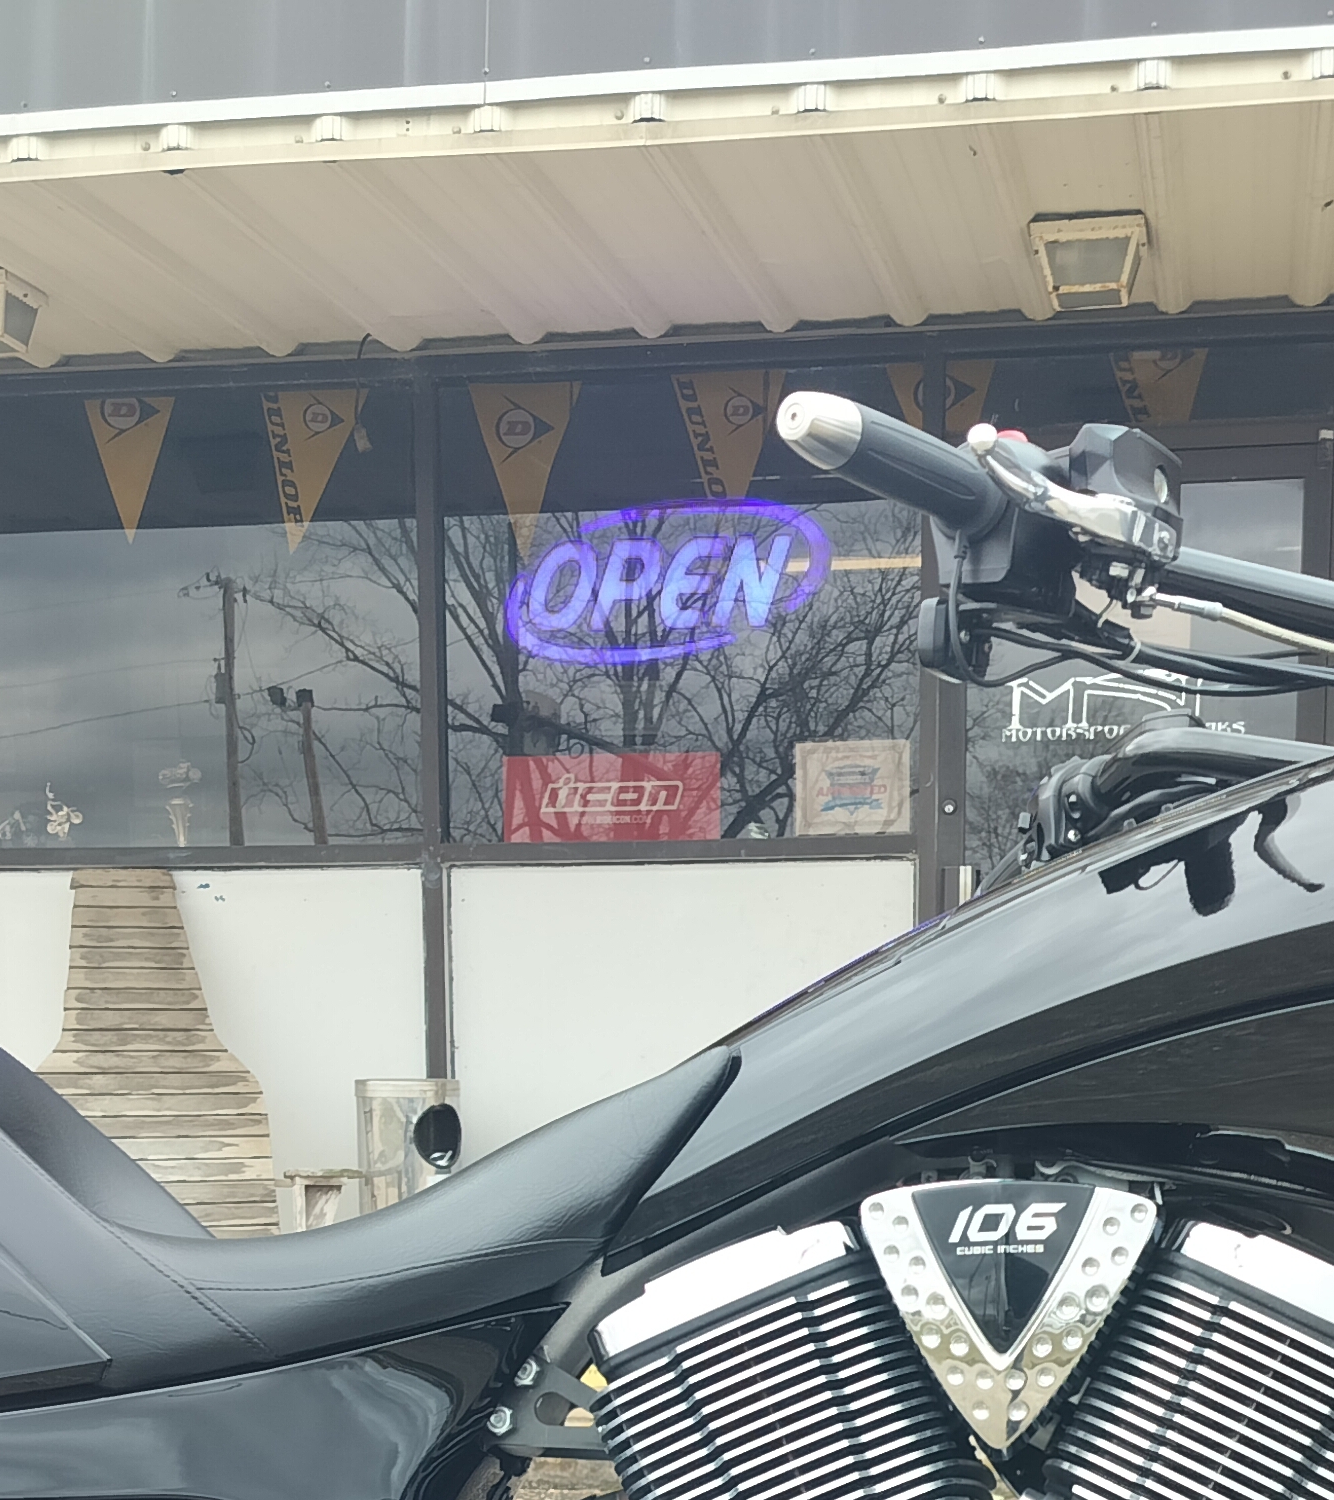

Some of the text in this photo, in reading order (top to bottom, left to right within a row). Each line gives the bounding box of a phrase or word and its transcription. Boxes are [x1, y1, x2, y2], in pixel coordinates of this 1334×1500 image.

[675, 378, 728, 500] DUNLO
[526, 534, 792, 631] OPEN
[948, 1202, 1067, 1243] 106
[956, 1244, 1045, 1256] CUBIC INCHES
